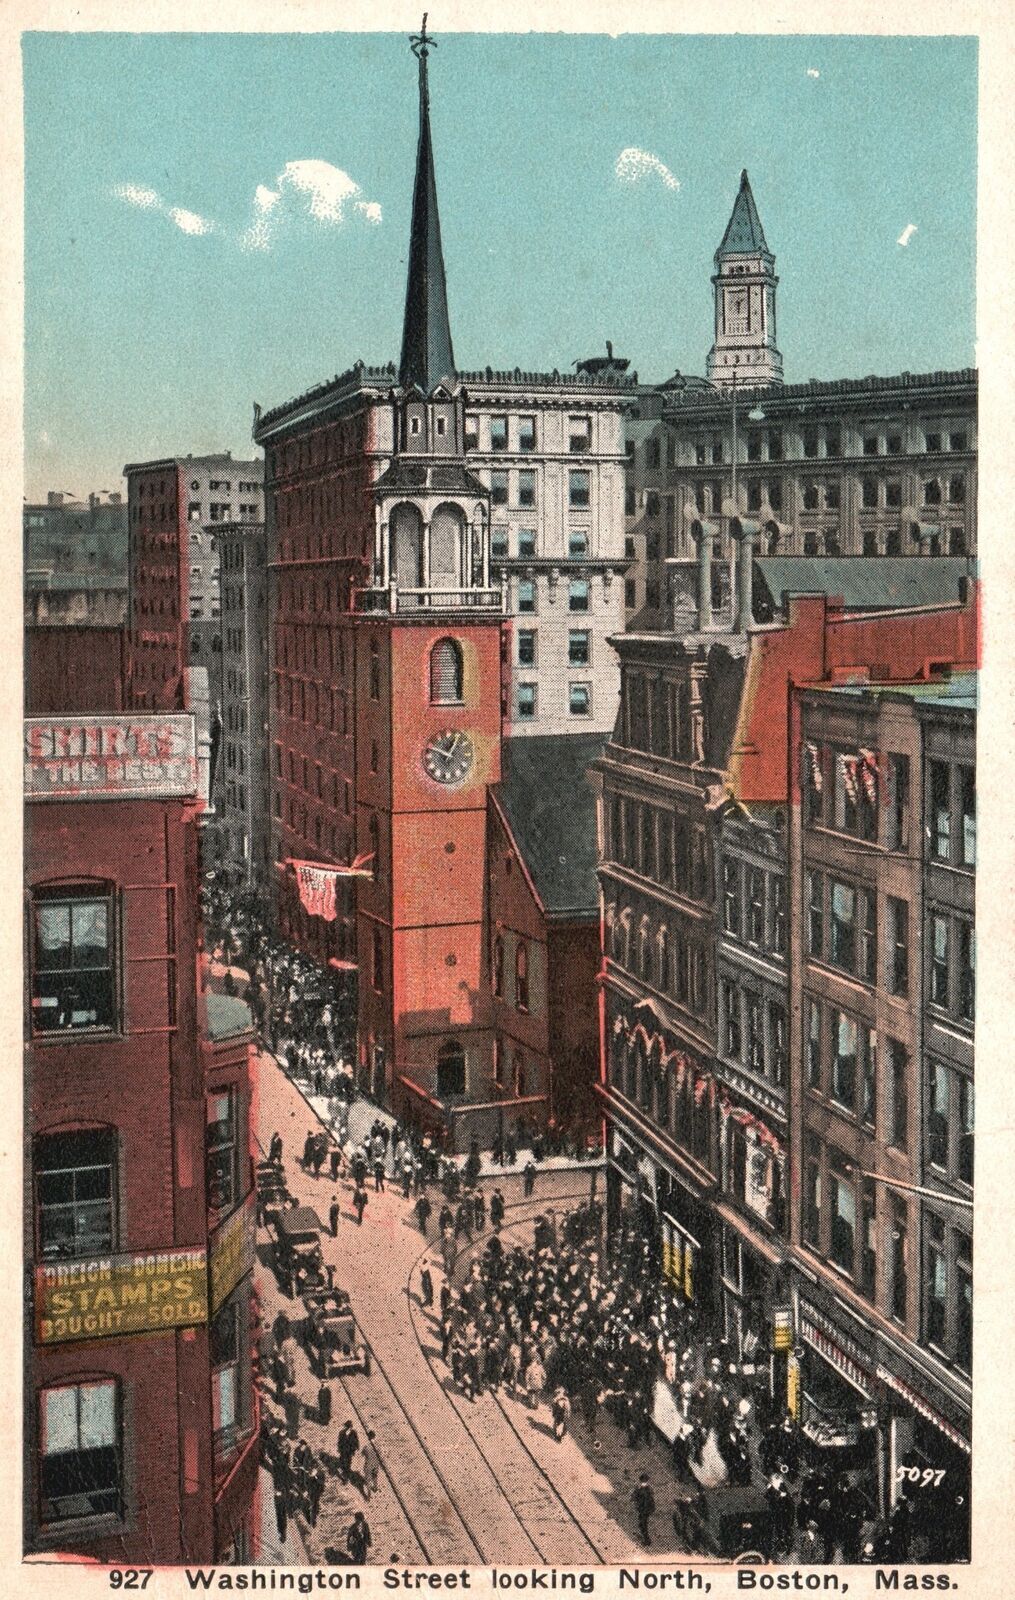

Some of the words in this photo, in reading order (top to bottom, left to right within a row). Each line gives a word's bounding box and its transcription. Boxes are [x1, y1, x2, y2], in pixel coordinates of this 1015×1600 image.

[26, 724, 187, 757] SHIRTS
[44, 760, 98, 782] THE
[51, 1276, 194, 1315] STAMPS
[40, 1310, 125, 1338] BOUGHT
